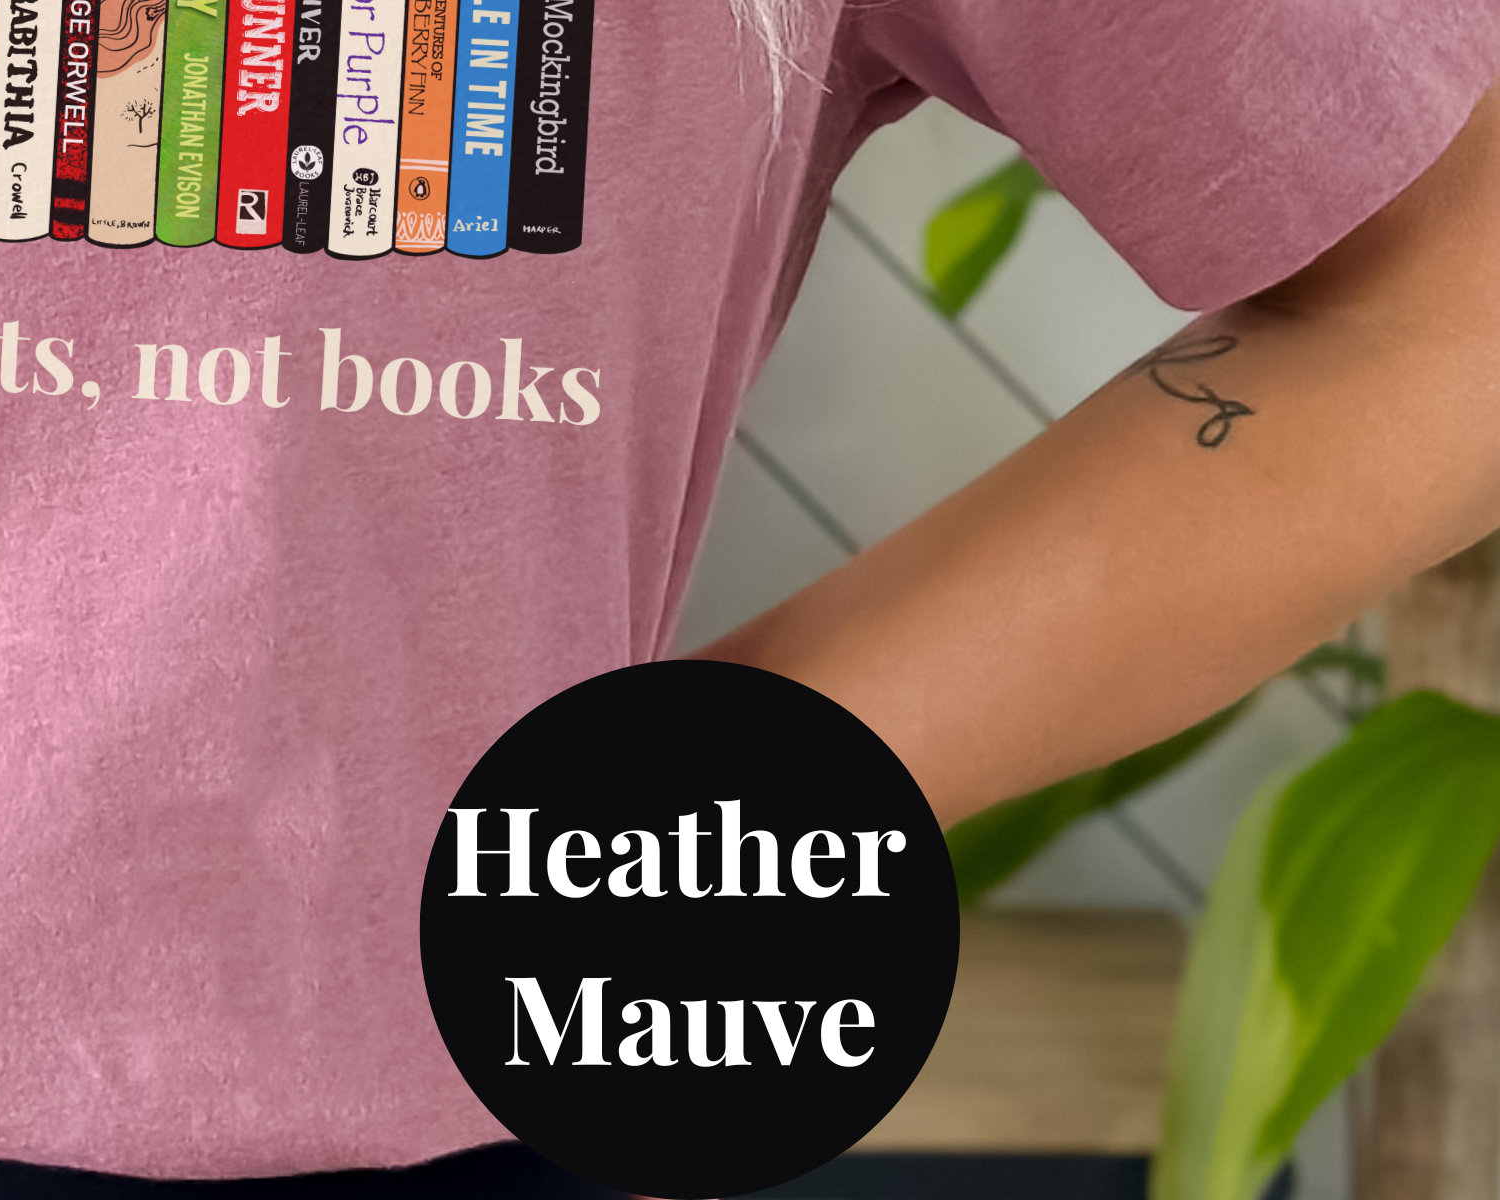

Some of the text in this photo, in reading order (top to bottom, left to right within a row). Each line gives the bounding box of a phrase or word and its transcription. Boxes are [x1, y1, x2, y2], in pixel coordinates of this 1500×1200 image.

[431, 61, 443, 81] OF
[470, 38, 509, 69] IN
[62, 42, 89, 154] ORWELL
[337, 31, 395, 145] Purple
[408, 72, 427, 116] FINN
[175, 52, 210, 218] JONATHAN EVISON
[465, 80, 507, 156] TIME
[9, 162, 27, 219] Crowell
[295, 171, 319, 179] BOOKS
[294, 181, 310, 246] LAUREL-LEAF
[355, 188, 367, 216] Brace
[366, 188, 381, 236] Harcourt
[452, 216, 499, 232] Ariel
[132, 334, 292, 409] not
[318, 328, 603, 426] books
